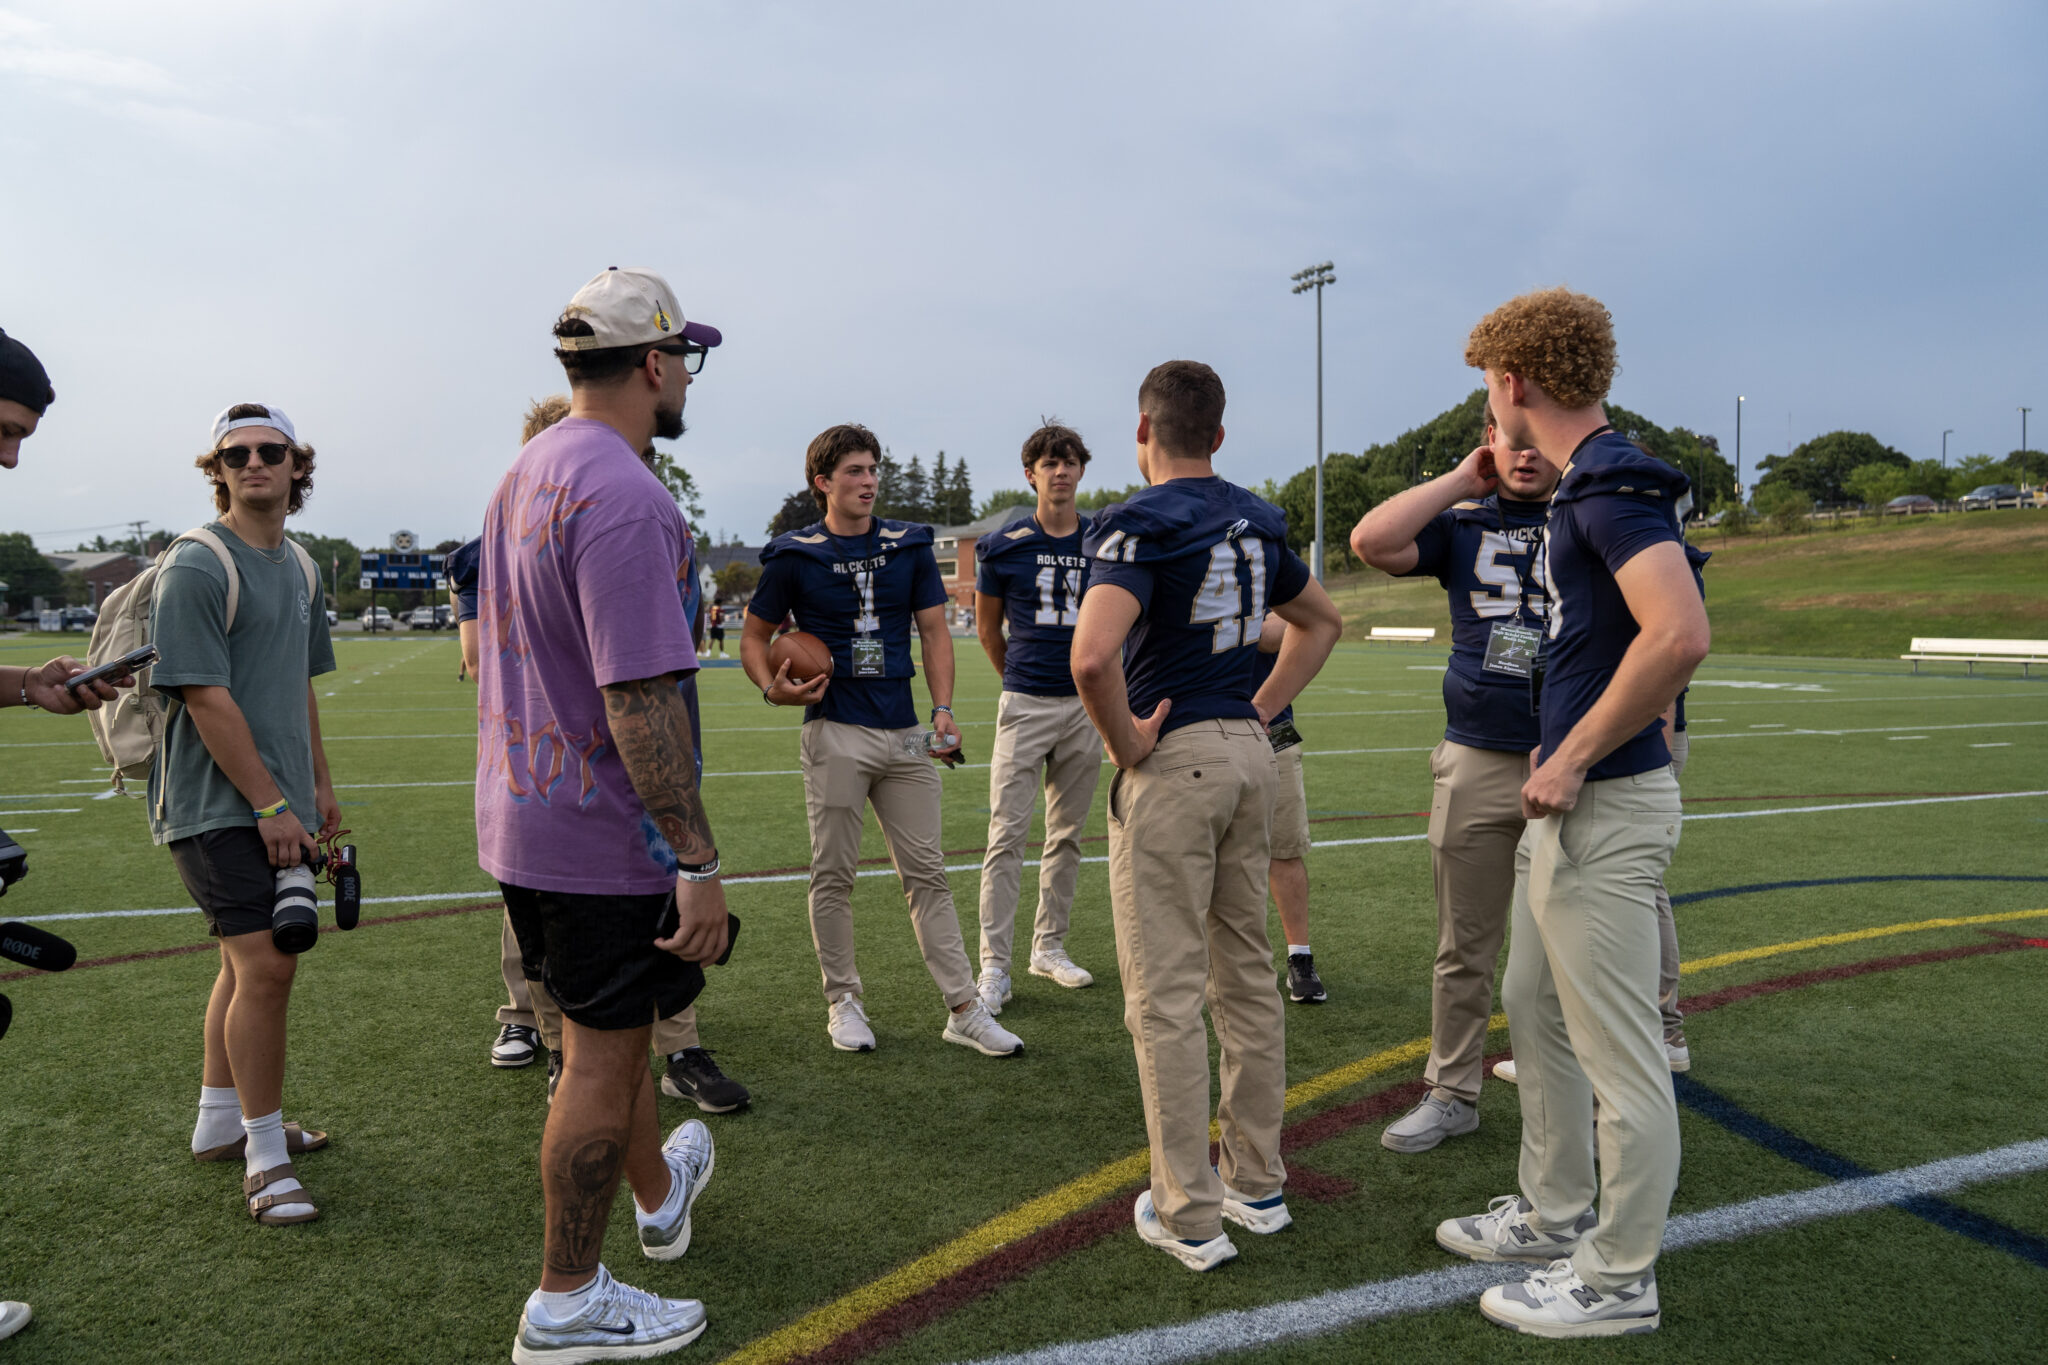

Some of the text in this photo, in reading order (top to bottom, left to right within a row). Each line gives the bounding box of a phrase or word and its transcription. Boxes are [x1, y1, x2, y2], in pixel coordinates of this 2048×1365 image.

[1037, 554, 1086, 568] ROCKETS
[1096, 530, 1140, 563] 41
[853, 571, 880, 632] 1
[1035, 567, 1082, 626] 11
[1189, 537, 1266, 655] 41
[1510, 1223, 1538, 1244] N
[1570, 1284, 1603, 1308] N
